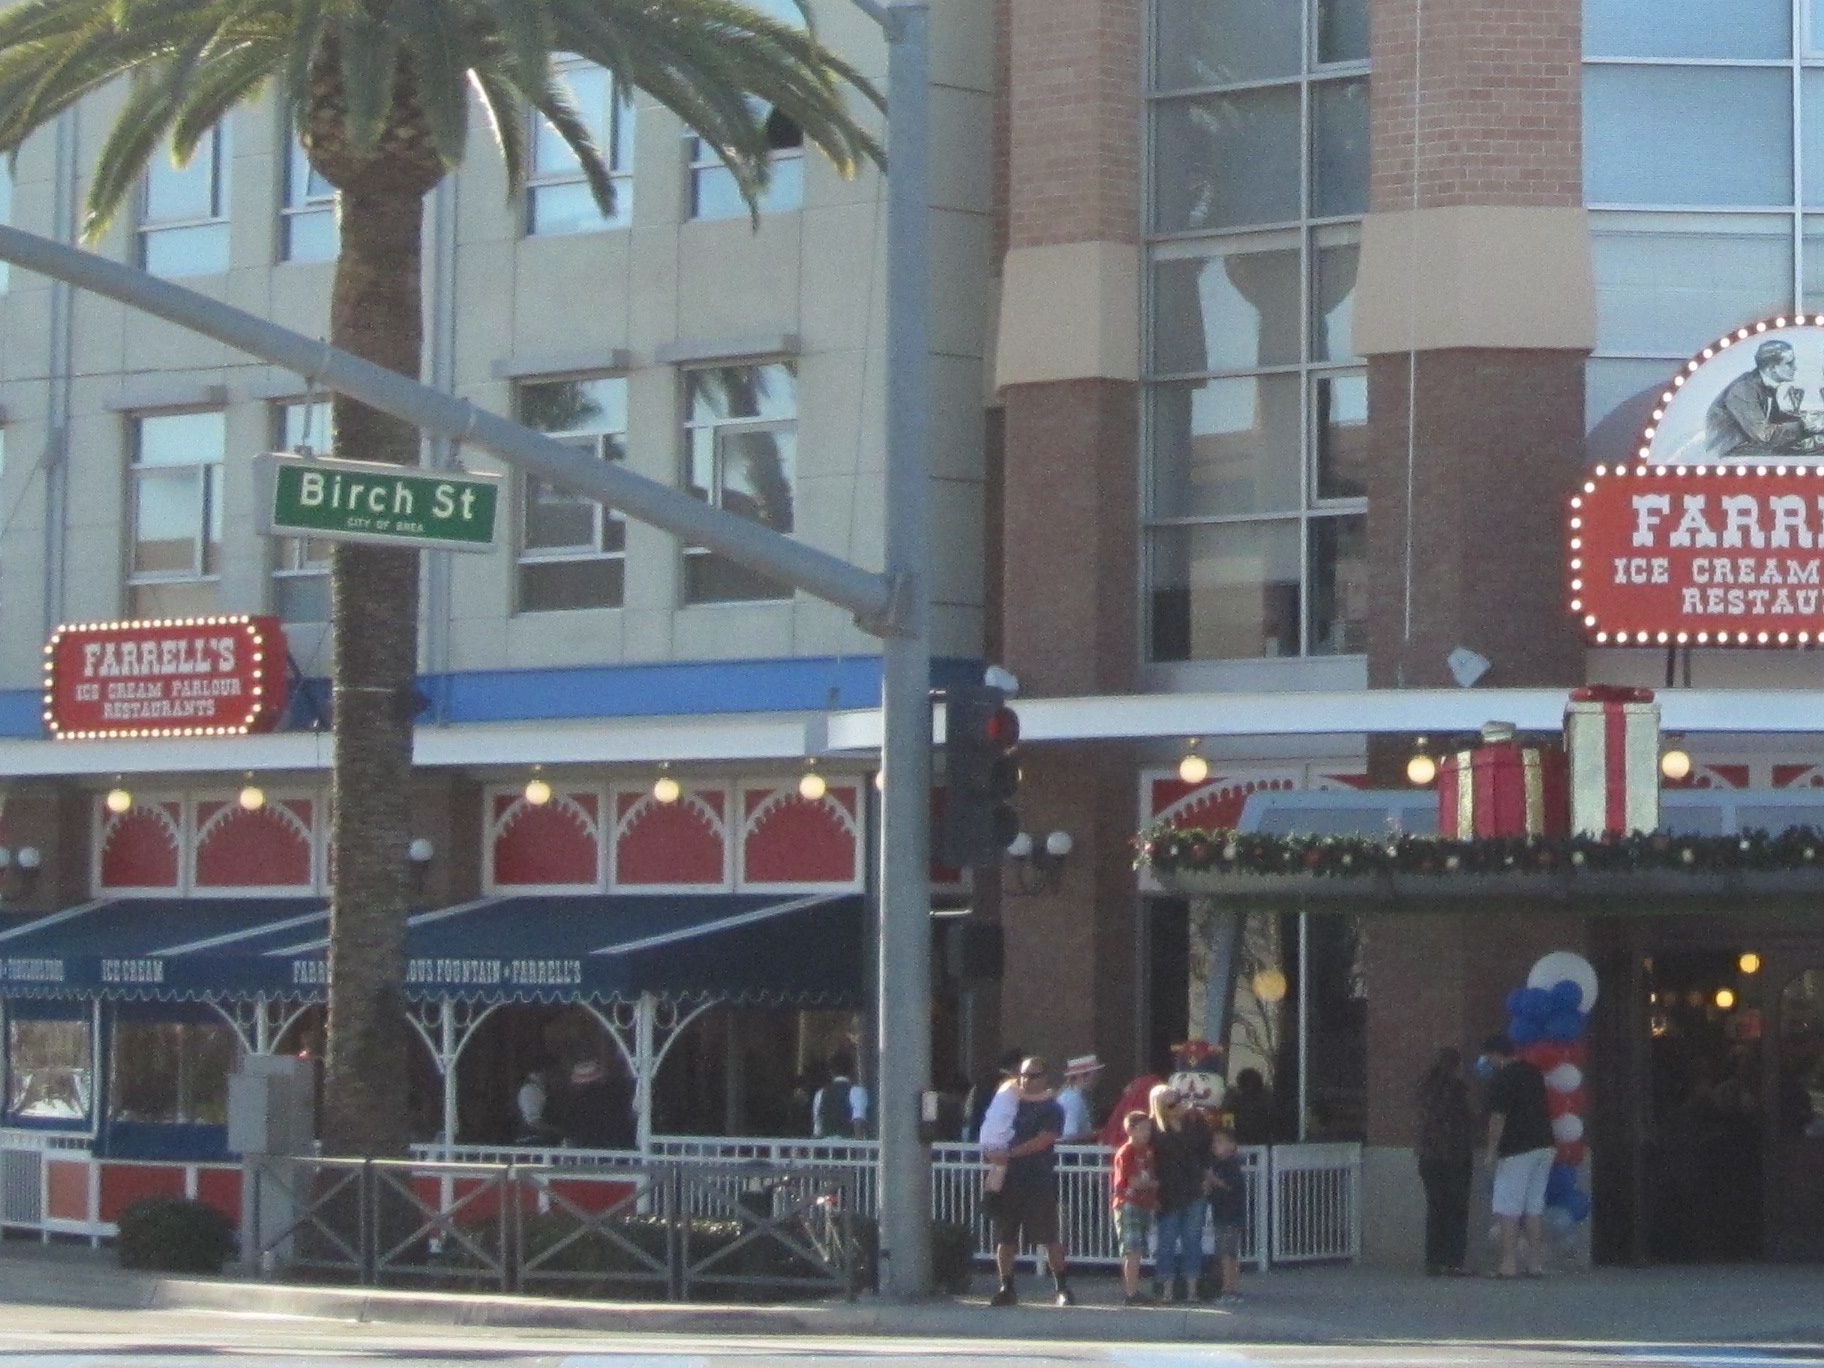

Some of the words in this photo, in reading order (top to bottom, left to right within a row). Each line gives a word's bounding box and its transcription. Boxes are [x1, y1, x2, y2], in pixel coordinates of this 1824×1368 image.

[300, 471, 414, 516] Birch
[431, 484, 476, 520] St
[347, 517, 371, 529] CITY
[376, 520, 391, 531] OF
[1613, 558, 1670, 584] ICE
[1691, 558, 1821, 585] CREAM
[82, 637, 236, 677] FARRELL'S
[75, 683, 99, 702] ICE
[107, 680, 162, 700] CREAM
[170, 678, 242, 698] PARLOUR
[103, 698, 216, 720] RESTAURANTS
[436, 959, 501, 982] FOUNTAIN
[511, 959, 581, 984] FARRELL'S
